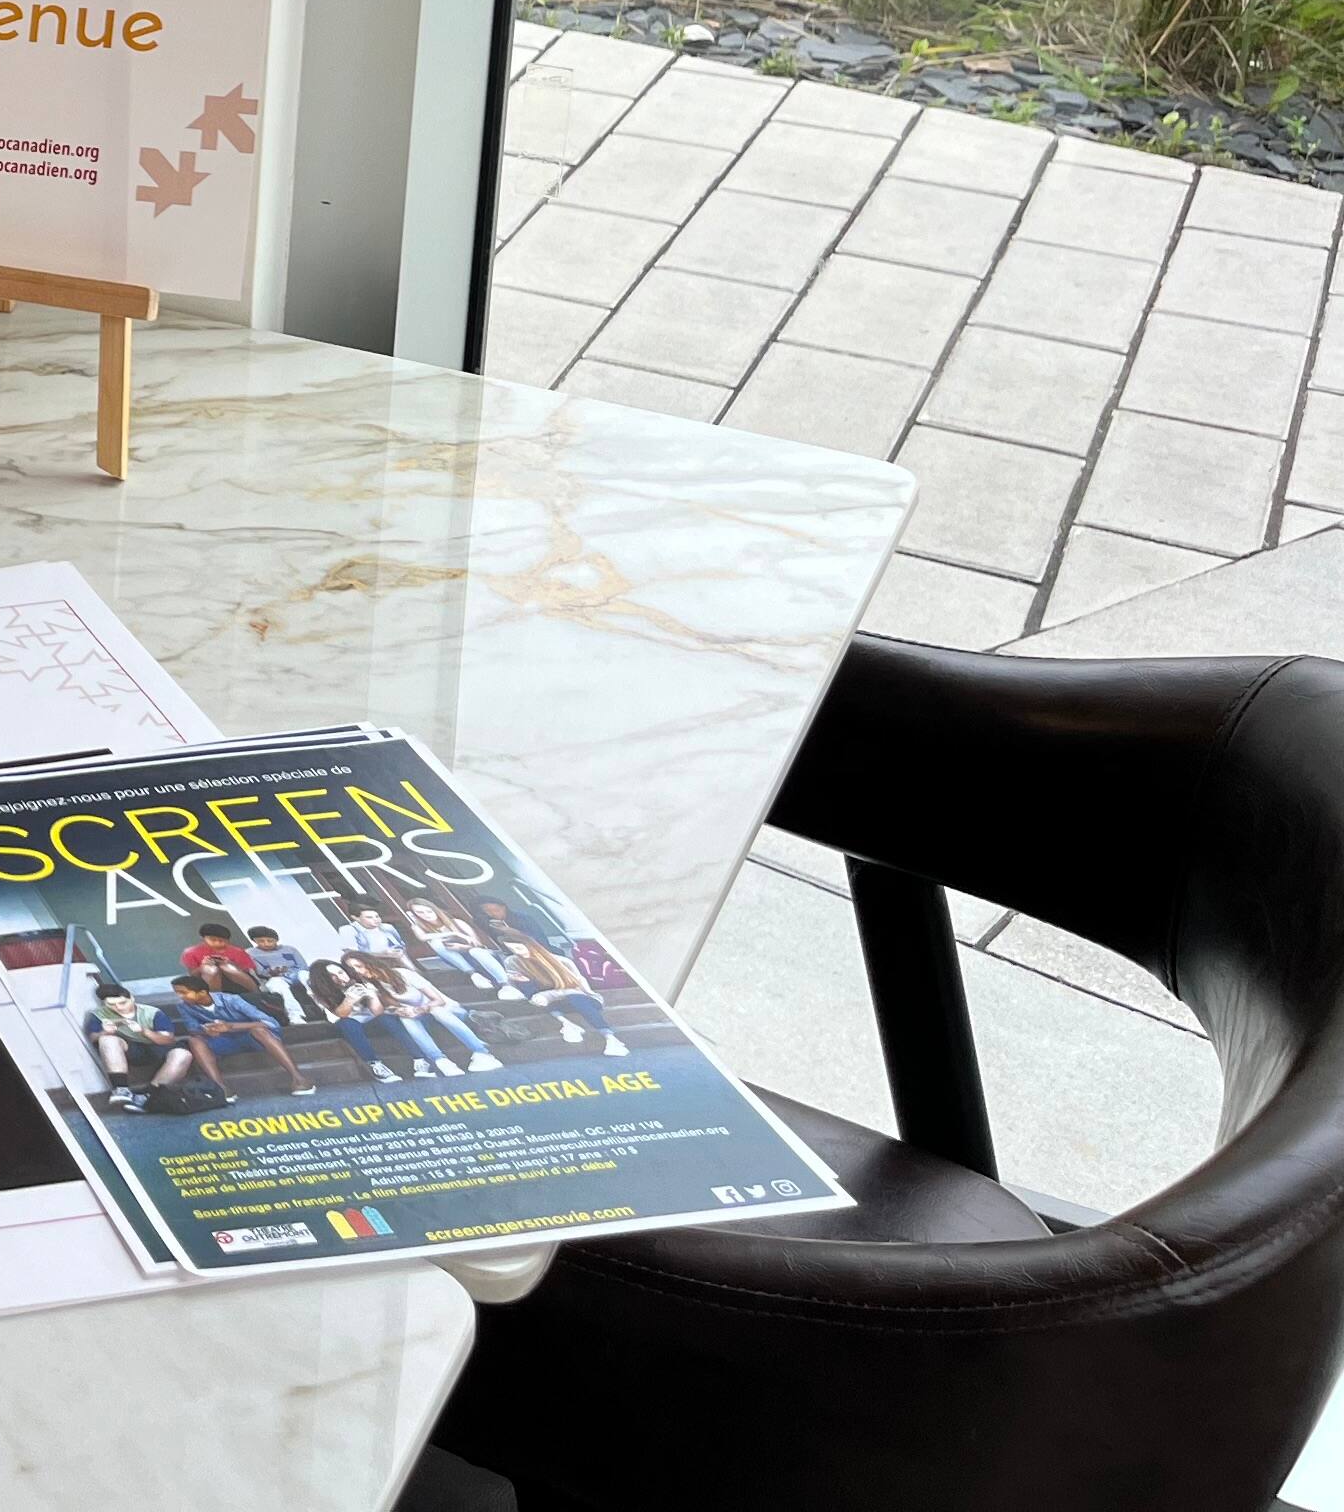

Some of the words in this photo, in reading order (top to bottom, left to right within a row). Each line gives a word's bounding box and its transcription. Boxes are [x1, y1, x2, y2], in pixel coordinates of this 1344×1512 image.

[114, 786, 150, 801] pour
[155, 782, 186, 794] une
[188, 773, 260, 791] sélection
[262, 767, 328, 784] spéciale
[330, 764, 353, 775] de
[105, 827, 495, 925] AGERS
[200, 1109, 343, 1142] GROWING
[342, 1103, 384, 1125] UP
[386, 1099, 425, 1121] IN
[423, 1090, 488, 1116] THE
[485, 1078, 600, 1108] DIGITAL
[601, 1071, 662, 1094] AGE
[165, 1165, 195, 1177] Date
[197, 1163, 211, 1172] et
[211, 1160, 249, 1171] heure
[257, 1151, 319, 1165] Vendredi,
[342, 1144, 384, 1156] février
[418, 1137, 435, 1146] de
[486, 1125, 524, 1138] 20h30
[172, 1174, 220, 1187] Endroit
[383, 1149, 430, 1162] avenue
[430, 1141, 483, 1156] Bernard
[609, 1122, 636, 1134] H2V
[218, 1149, 240, 1161] par
[248, 1146, 266, 1155] Le
[266, 1141, 310, 1154] Centre
[310, 1134, 362, 1148] Culturel
[361, 1122, 467, 1142] Libano-Canadien
[180, 1185, 218, 1199] Achat
[220, 1183, 236, 1193] de
[236, 1178, 277, 1191] billets
[278, 1176, 295, 1186] en
[295, 1173, 329, 1185] ligne
[330, 1170, 352, 1180] sur
[360, 1155, 477, 1177] www.eventbrite.ca
[477, 1152, 496, 1161] ou
[192, 1202, 272, 1220] Sous-titrage
[273, 1200, 291, 1210] en
[292, 1193, 345, 1208] français
[353, 1191, 371, 1200] Le
[372, 1188, 398, 1199] film
[399, 1177, 487, 1195] documentaire
[488, 1173, 517, 1184] sera
[518, 1167, 550, 1180] suivi
[580, 1159, 618, 1172] débat
[370, 1173, 419, 1187] Adultes
[465, 1162, 511, 1175] Jeunes
[560, 1152, 574, 1163] 17
[578, 1150, 603, 1160] ans
[611, 1146, 627, 1157] 10
[424, 1205, 636, 1242] screenagersmovie.com
